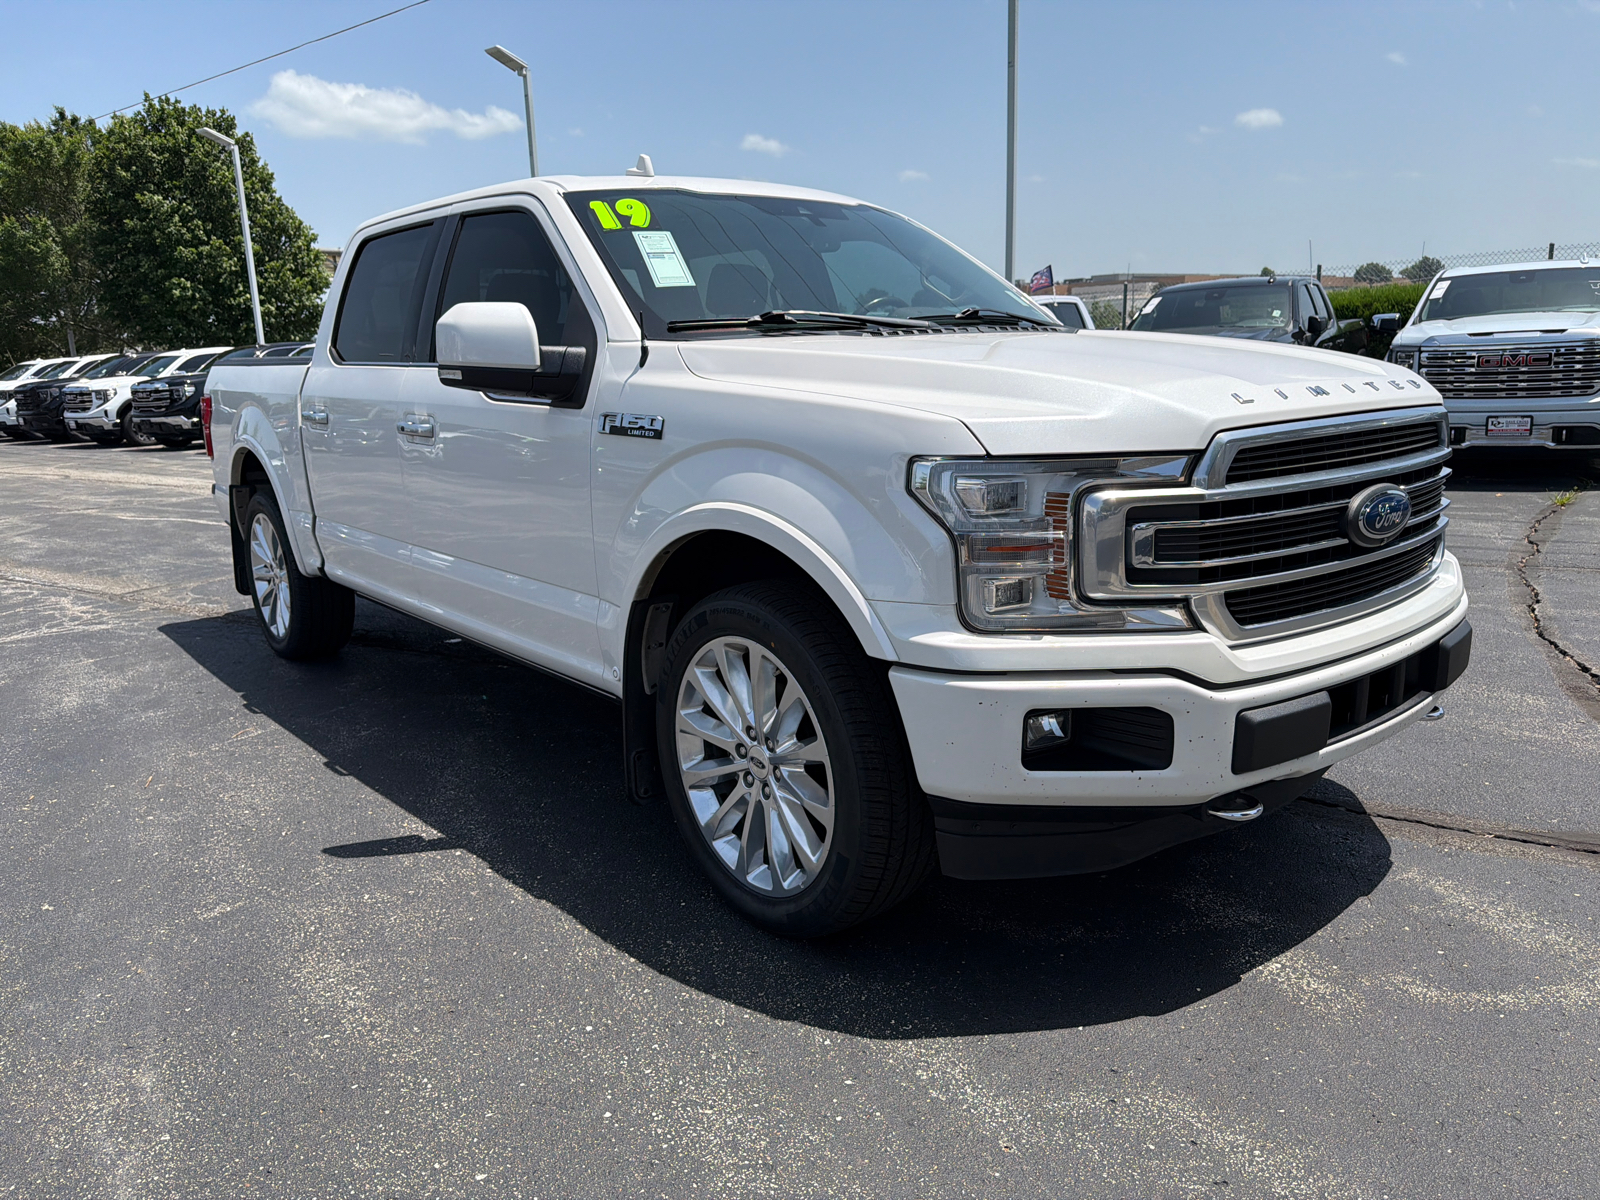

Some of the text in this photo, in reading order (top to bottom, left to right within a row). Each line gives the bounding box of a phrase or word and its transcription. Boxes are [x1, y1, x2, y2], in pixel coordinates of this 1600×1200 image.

[589, 198, 651, 230] 19
[1480, 353, 1550, 367] GMC
[1230, 379, 1422, 405] LIMITED
[627, 429, 655, 437] LIMITED
[1375, 503, 1404, 529] Ford
